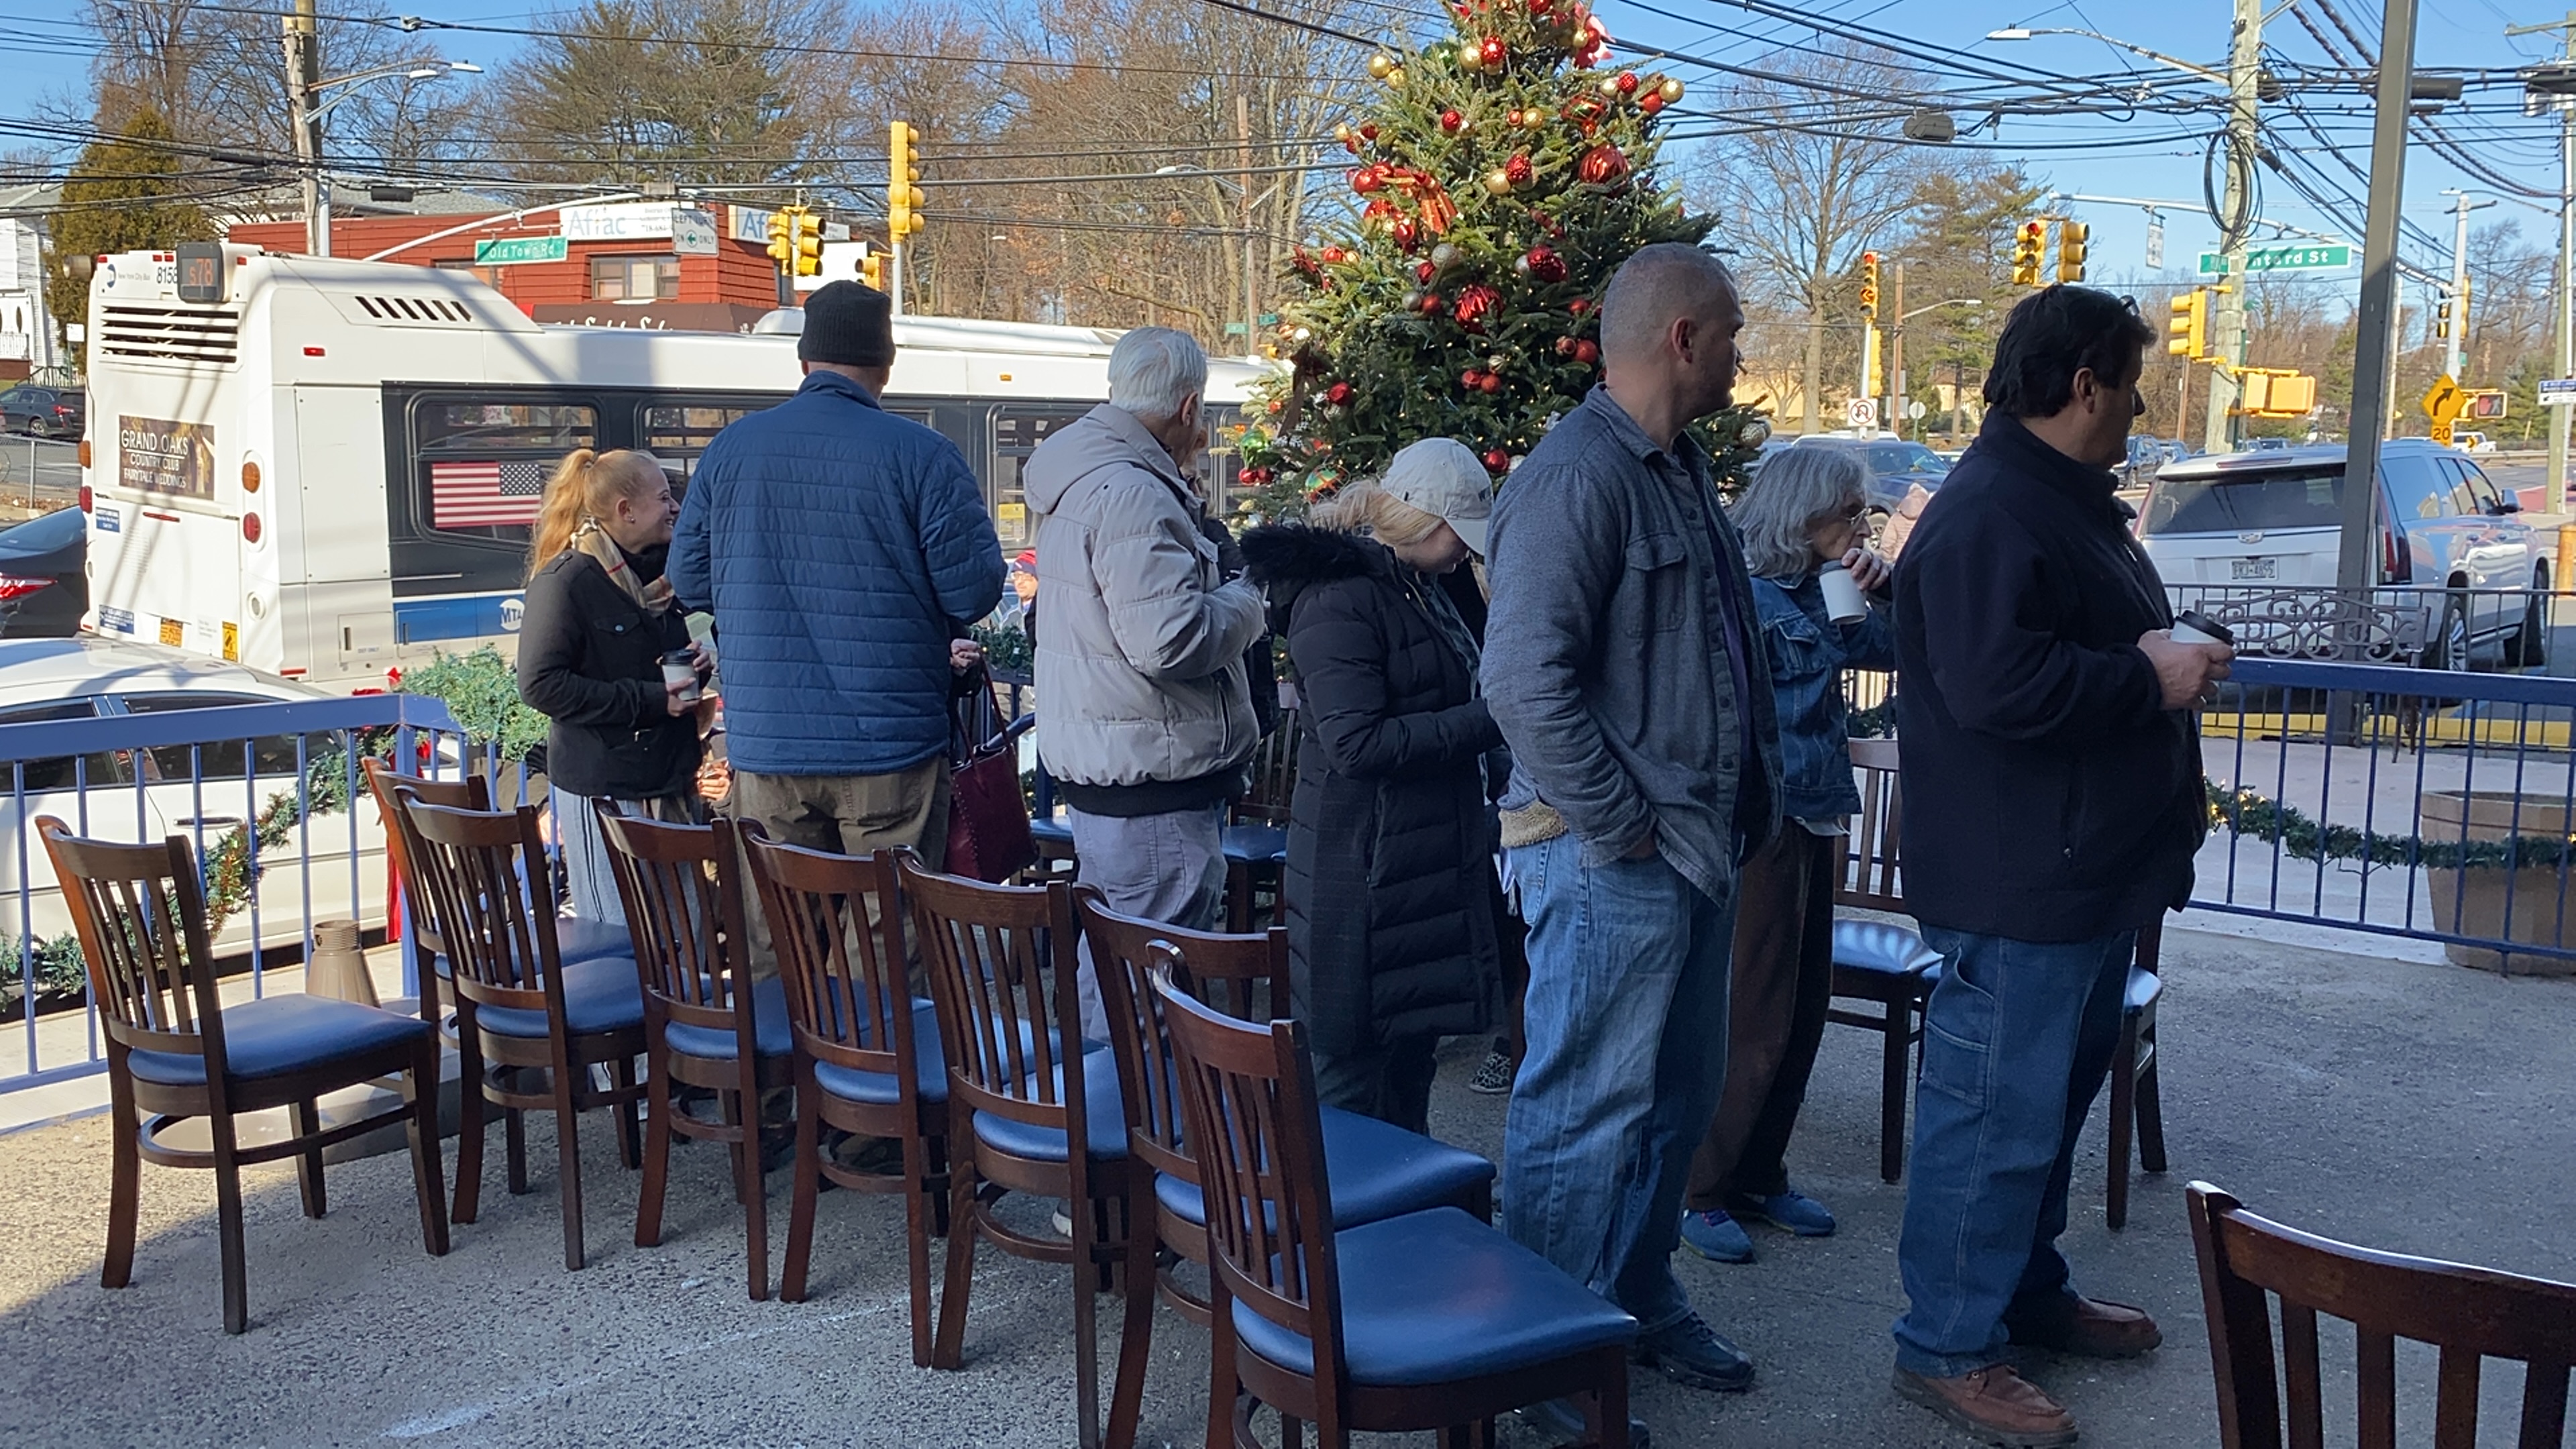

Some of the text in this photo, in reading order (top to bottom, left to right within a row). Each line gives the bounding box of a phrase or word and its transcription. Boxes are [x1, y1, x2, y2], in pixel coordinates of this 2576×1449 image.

[699, 235, 714, 244] ONLY
[489, 247, 508, 258] Old
[541, 244, 555, 256] Rd
[2308, 250, 2329, 264] St
[156, 266, 178, 284] 8158
[121, 429, 189, 455] GRAND OAKS
[2433, 427, 2451, 440] 20
[129, 453, 180, 472] COUNTRY CLUB
[124, 468, 186, 489] FAIRYTALE WEDDINGS
[500, 607, 523, 624] MTA
